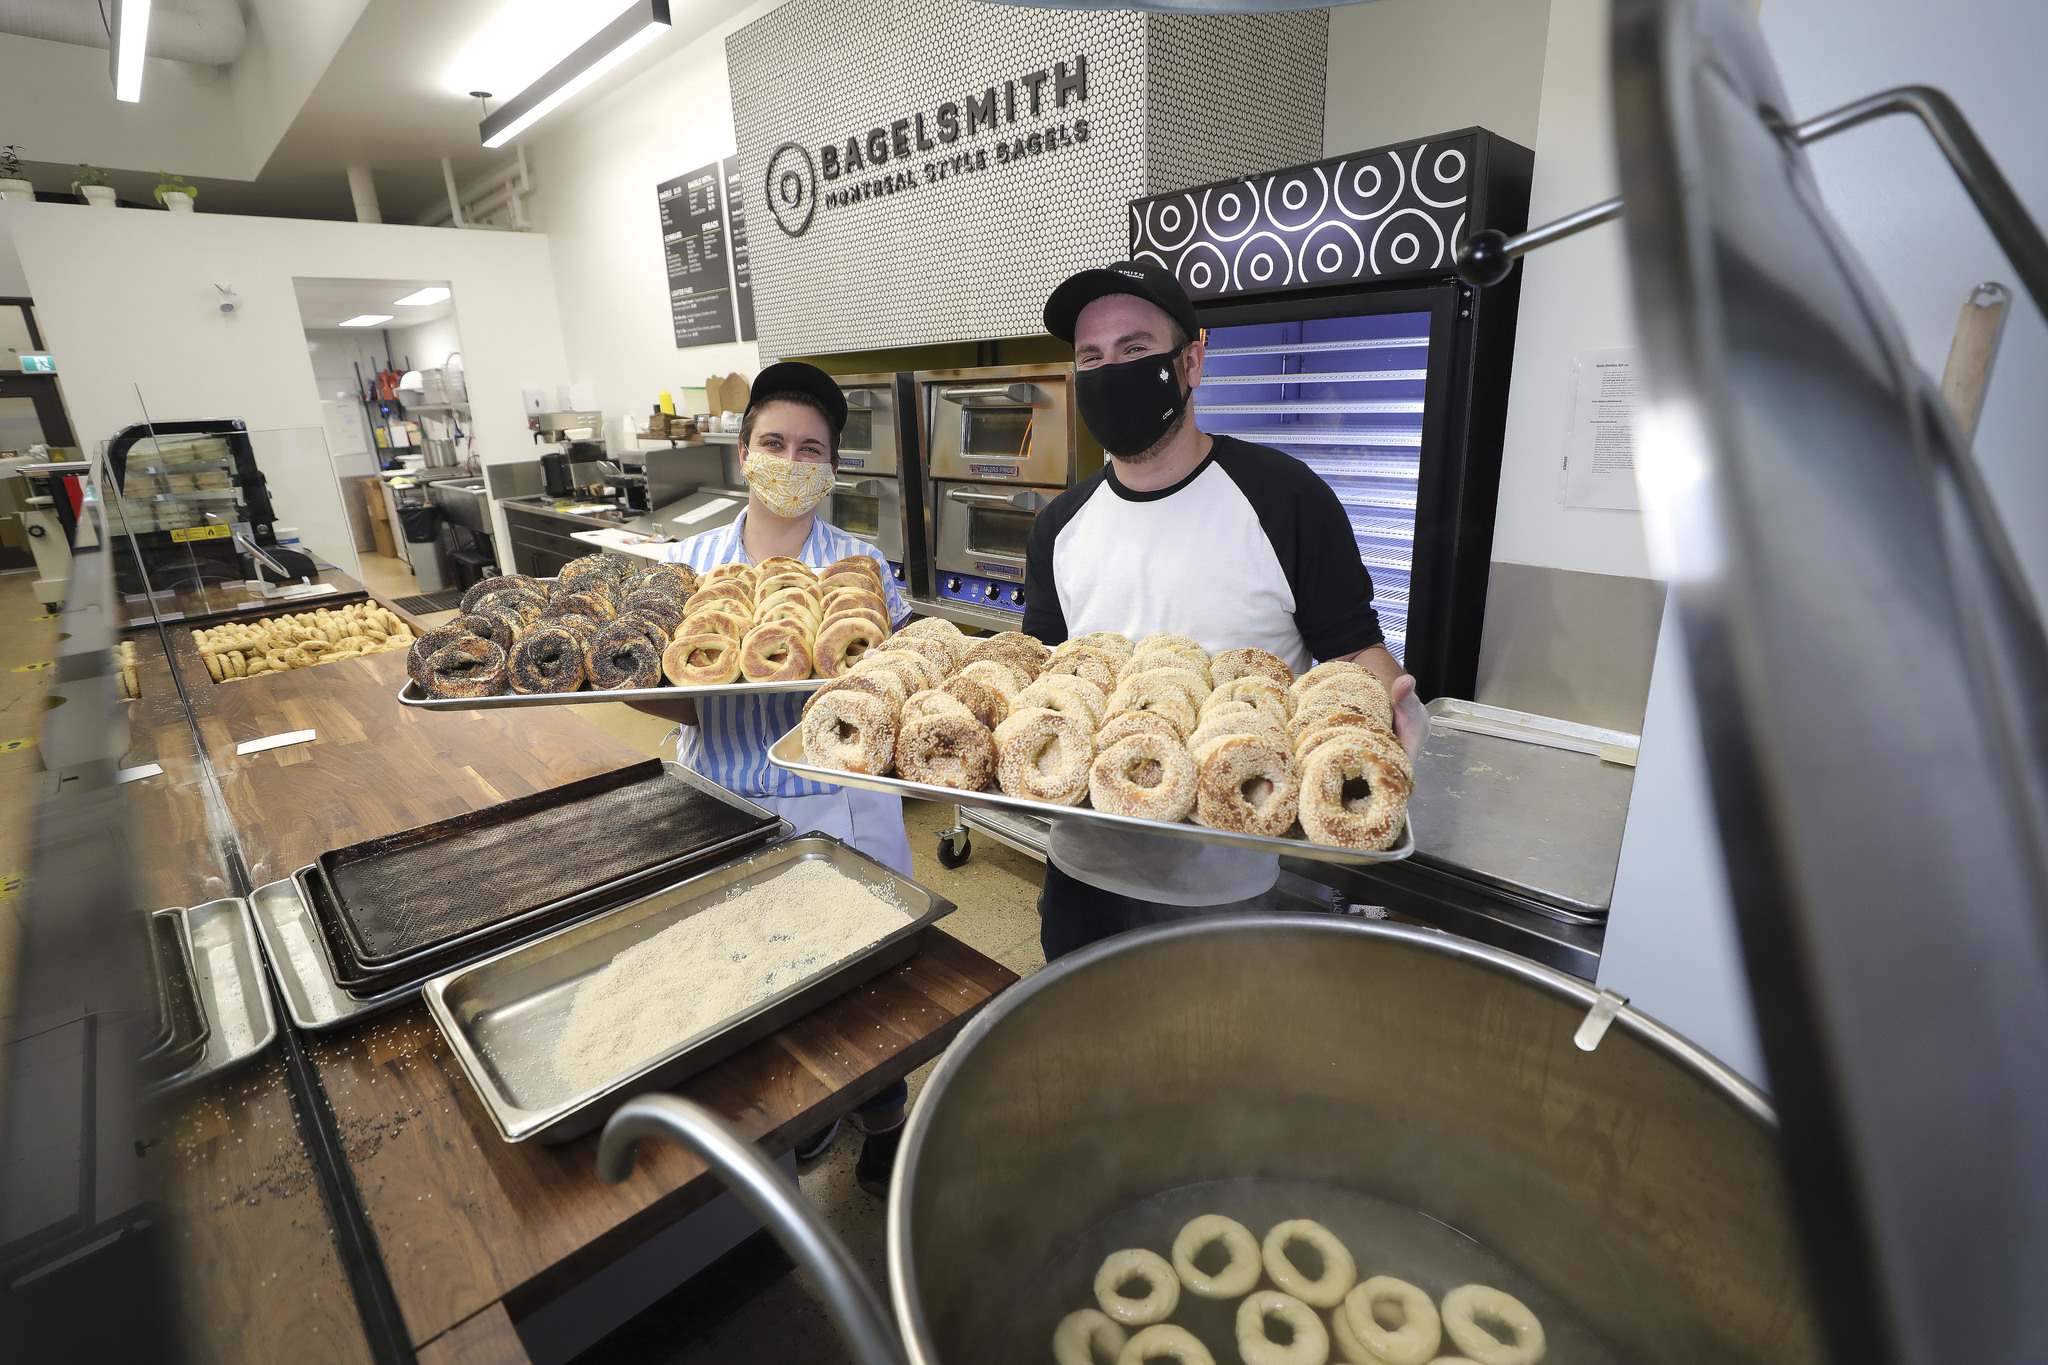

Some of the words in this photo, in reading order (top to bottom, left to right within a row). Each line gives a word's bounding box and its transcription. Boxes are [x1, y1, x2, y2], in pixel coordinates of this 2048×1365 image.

[820, 54, 1087, 180] BAGELSMITH
[826, 169, 918, 210] MONTREAL
[924, 148, 987, 183] STYLE
[996, 118, 1089, 165] BAGELS
